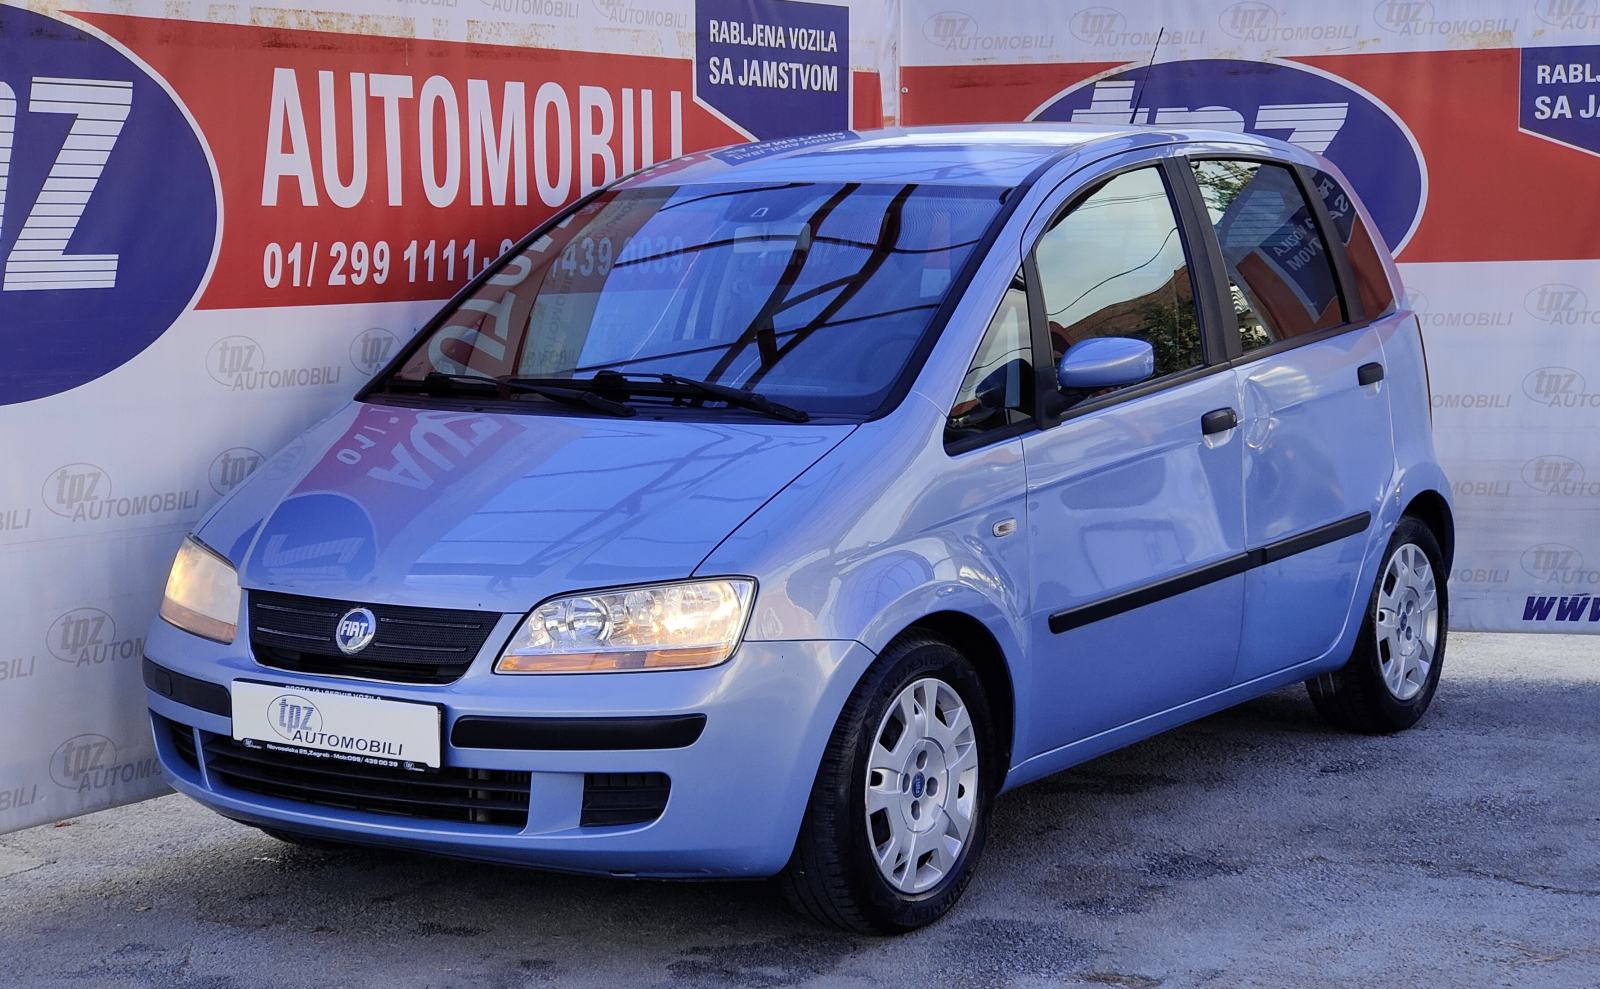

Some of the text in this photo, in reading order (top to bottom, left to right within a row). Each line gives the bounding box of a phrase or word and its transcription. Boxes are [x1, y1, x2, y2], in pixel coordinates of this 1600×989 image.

[609, 7, 687, 28] AUTOMOBILI
[1400, 18, 1519, 36] AUTOMOBILI
[709, 20, 838, 52] RABLJENA VOZILA
[946, 36, 1054, 50] AUTOMOBILI
[1093, 31, 1205, 47] AUTOMOBILI
[1244, 25, 1359, 42] AUTOMOBILI
[709, 57, 838, 92] SA JAMSTVOM
[1534, 95, 1572, 120] SA
[261, 67, 683, 208] AUTOMOBILI
[263, 241, 318, 289] 01/
[328, 240, 390, 286] 299
[1419, 312, 1513, 327] TOMOBILI
[232, 366, 341, 391] AUTOMOBILI
[72, 490, 200, 522] AUTOMOBILI
[340, 620, 368, 638] FIAT
[279, 698, 314, 734] tpz
[292, 729, 403, 756] AUTOMOBILI
